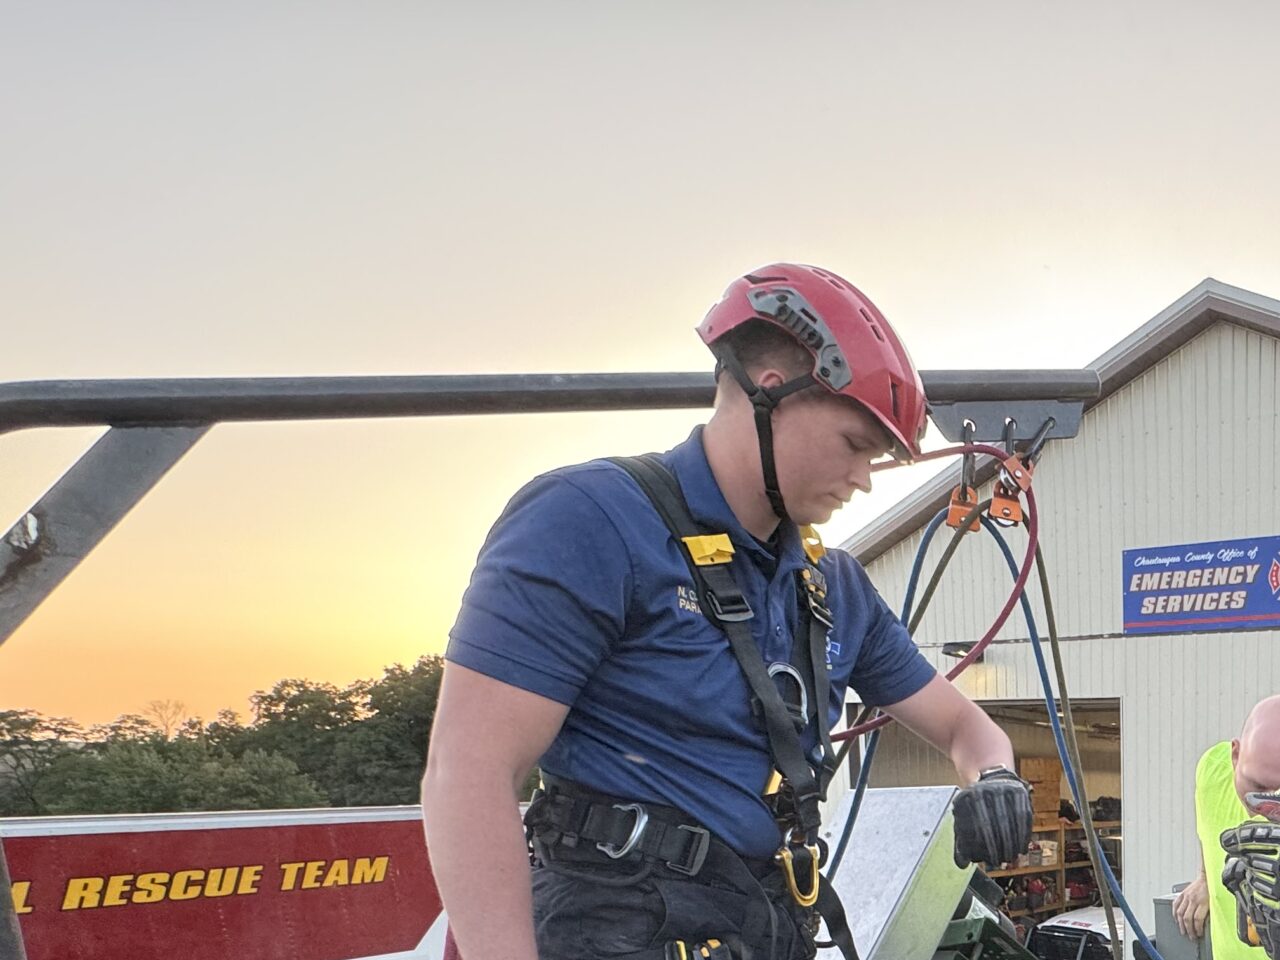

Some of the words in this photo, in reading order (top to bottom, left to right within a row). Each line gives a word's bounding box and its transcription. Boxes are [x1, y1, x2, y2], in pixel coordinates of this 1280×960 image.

[1184, 552, 1215, 564] County
[1216, 548, 1245, 562] Office
[1247, 546, 1258, 560] of
[1129, 564, 1260, 592] EMERGENCY
[1140, 590, 1247, 614] SERVICES
[61, 864, 264, 912] RESCUE
[280, 856, 390, 892] TEAM
